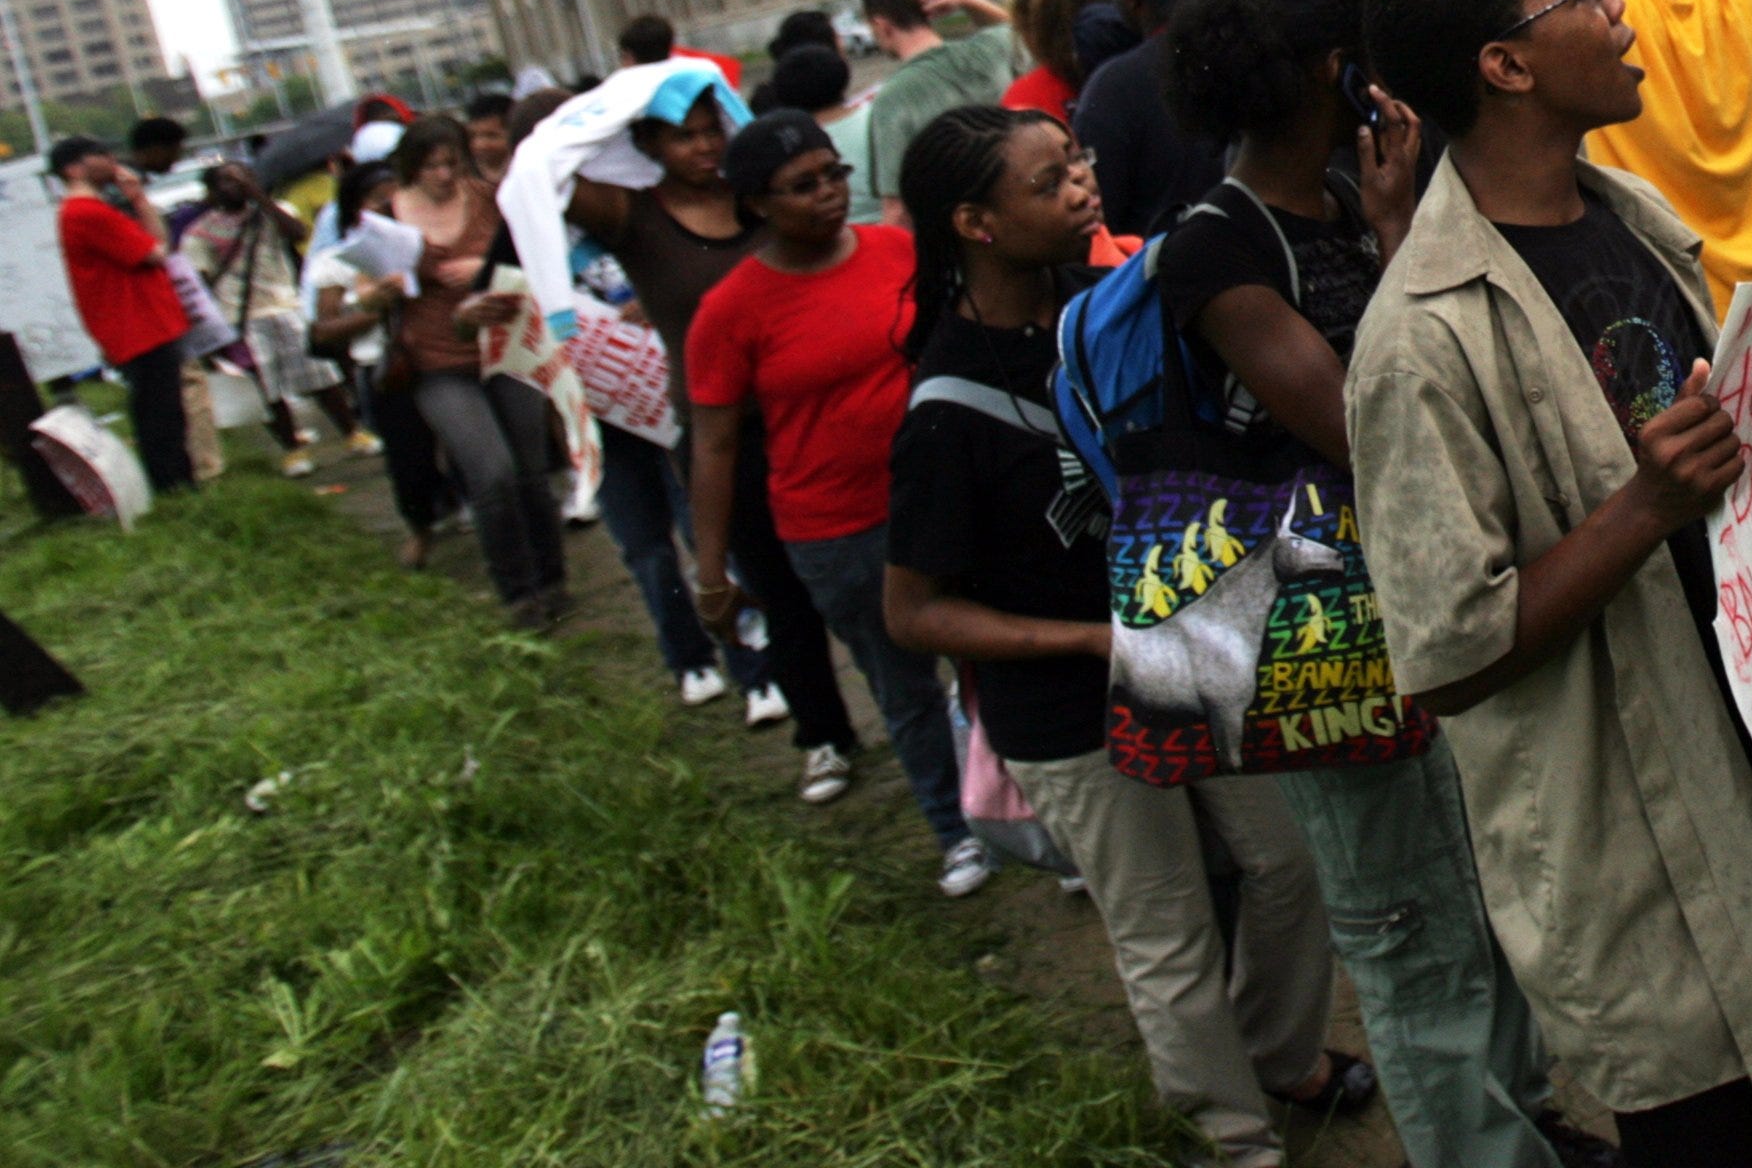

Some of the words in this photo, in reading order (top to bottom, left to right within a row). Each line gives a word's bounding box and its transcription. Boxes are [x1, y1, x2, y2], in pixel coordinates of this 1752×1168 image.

[1335, 504, 1361, 544] A
[1348, 591, 1382, 625] TH
[1278, 695, 1405, 752] KING!
